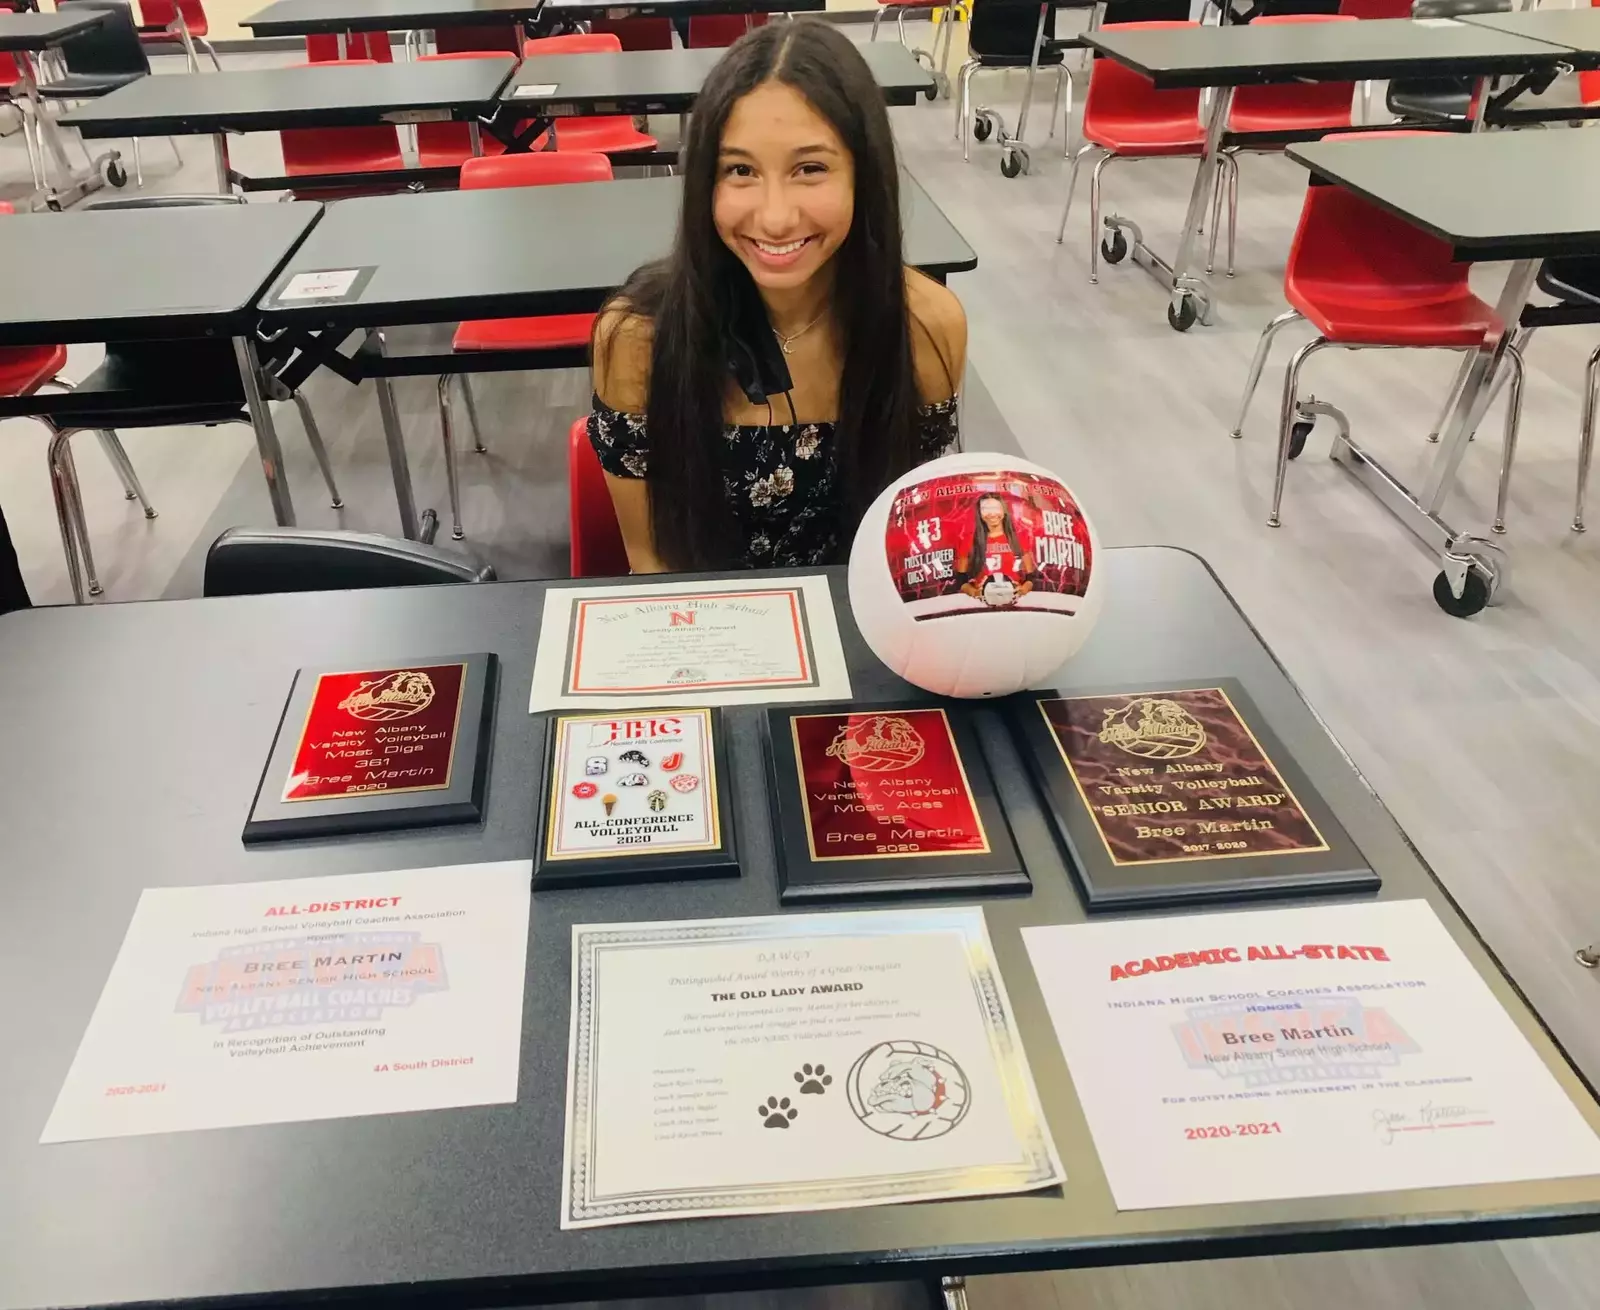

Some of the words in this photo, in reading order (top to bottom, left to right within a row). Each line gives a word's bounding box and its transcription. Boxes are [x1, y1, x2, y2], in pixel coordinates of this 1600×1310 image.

[1042, 510, 1073, 540] BREE
[1036, 536, 1085, 571] MARTIN
[597, 611, 630, 624] New
[634, 602, 679, 616] Albany
[685, 599, 719, 611] High
[723, 602, 770, 617] School
[669, 610, 697, 627] N
[310, 739, 365, 750] Varsity
[375, 731, 446, 744] Volleyball
[332, 729, 366, 738] New
[374, 724, 426, 735] Albany
[325, 749, 373, 760] Most
[384, 743, 424, 755] Digs
[354, 758, 390, 768] 361
[1116, 766, 1154, 777] New
[1165, 762, 1224, 775] Albany
[304, 773, 352, 785] Bree
[365, 767, 434, 780] Martin
[834, 780, 869, 789] New
[879, 778, 932, 787] Albany
[346, 782, 388, 793] 2020
[814, 791, 873, 801] Varsity
[883, 787, 958, 797] Volleyball
[1098, 784, 1163, 796] Varsity
[1171, 776, 1263, 790] Volleyball
[834, 803, 885, 813] Most
[896, 801, 943, 810] Aces
[1094, 799, 1187, 817] "SENIOR
[1198, 793, 1286, 811] AWARD"
[573, 813, 694, 829] ALL-CONFERENCE
[589, 823, 679, 837] VOLLEYBALL
[1136, 825, 1186, 839] Bree
[1198, 818, 1274, 834] Martin
[616, 834, 652, 845] 2020
[826, 832, 877, 843] Bree
[891, 827, 963, 840] Martin
[876, 843, 919, 853] 2020
[1182, 841, 1248, 853] 2017-2020
[264, 896, 402, 917] ALL-DISTRICT
[190, 930, 231, 939] Indiana
[234, 927, 258, 936] High
[261, 923, 298, 933] School
[301, 918, 352, 931] Volleyball
[354, 914, 401, 925] Coaches
[403, 909, 466, 922] Association
[243, 960, 305, 974] BREE
[314, 952, 403, 969] MARTIN
[1109, 946, 1242, 982] ACADEMIC
[1247, 944, 1391, 962] ALL-STATE
[195, 985, 224, 994] NEW
[288, 976, 338, 986] SENIOR
[342, 972, 377, 982] HIGH
[382, 967, 435, 978] SCHOOL
[710, 992, 737, 1003] THE
[740, 989, 767, 1000] OLD
[770, 987, 806, 999] LADY
[810, 982, 864, 995] AWARD
[1107, 1000, 1165, 1010] INDIANA
[1170, 995, 1204, 1005] HIGH
[1209, 991, 1261, 1002] SCHOOL
[1266, 986, 1332, 998] COACHES
[1336, 979, 1427, 993] ASSOCIATION
[1245, 1002, 1303, 1014] HONORS
[227, 1036, 297, 1049] Recognition
[300, 1032, 312, 1042] of
[315, 1027, 386, 1041] Outstanding
[1221, 1030, 1275, 1045] Bree
[1280, 1024, 1355, 1042] Martin
[229, 1045, 286, 1058] Volleyball
[289, 1039, 365, 1053] Achievement
[1204, 1053, 1230, 1064] New
[1233, 1049, 1275, 1064] Albany
[1276, 1046, 1315, 1059] Senior
[1317, 1044, 1347, 1058] High
[1348, 1040, 1392, 1053] School
[373, 1063, 389, 1073] 4A
[393, 1060, 427, 1072] South
[431, 1056, 474, 1069] District
[105, 1082, 166, 1097] 2020-2021
[1162, 1097, 1186, 1105] FOR
[1189, 1091, 1271, 1103] OUTSTANDING
[1276, 1083, 1357, 1097] ACHIEVEMENT
[1378, 1080, 1400, 1088] THE
[1184, 1121, 1282, 1140] 2020-2021
